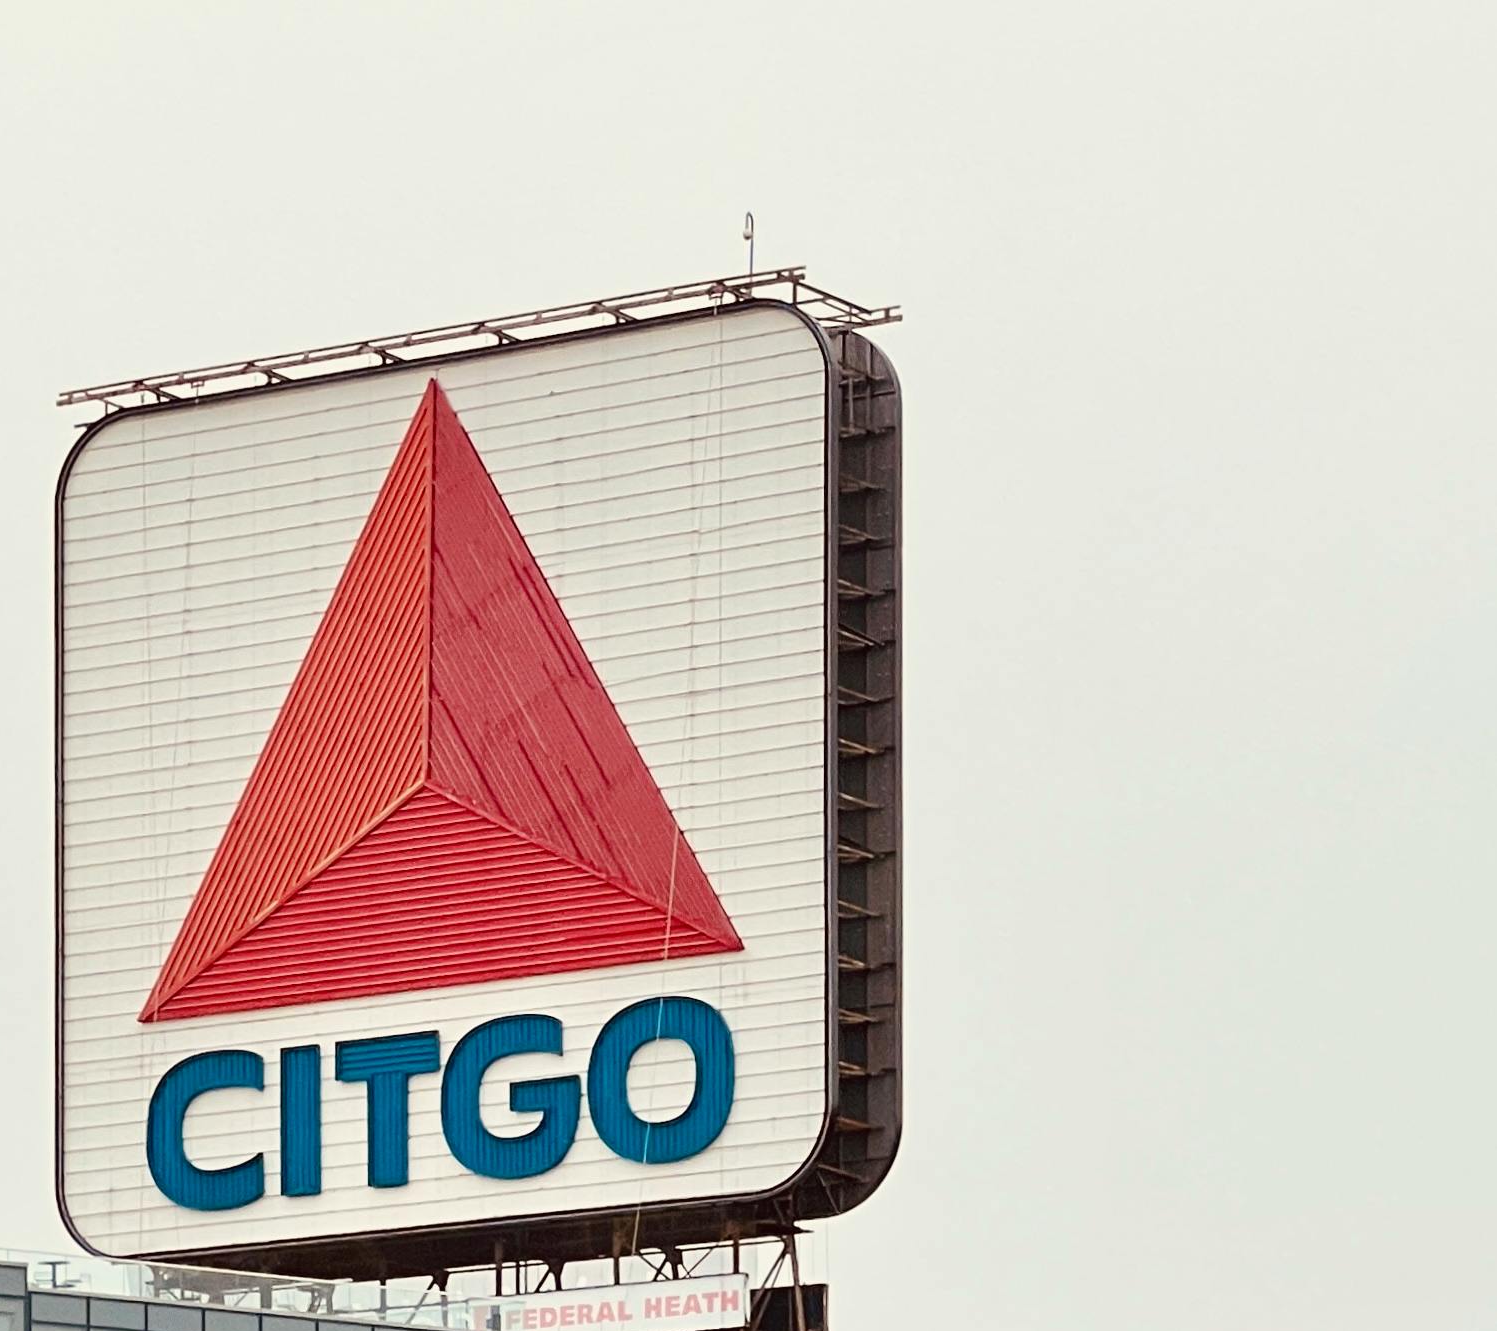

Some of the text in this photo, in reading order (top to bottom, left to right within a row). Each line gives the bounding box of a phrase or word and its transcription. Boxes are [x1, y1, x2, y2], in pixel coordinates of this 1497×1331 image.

[145, 995, 736, 1211] CITGO
[505, 1290, 739, 1330] FEDERAL HEATH
